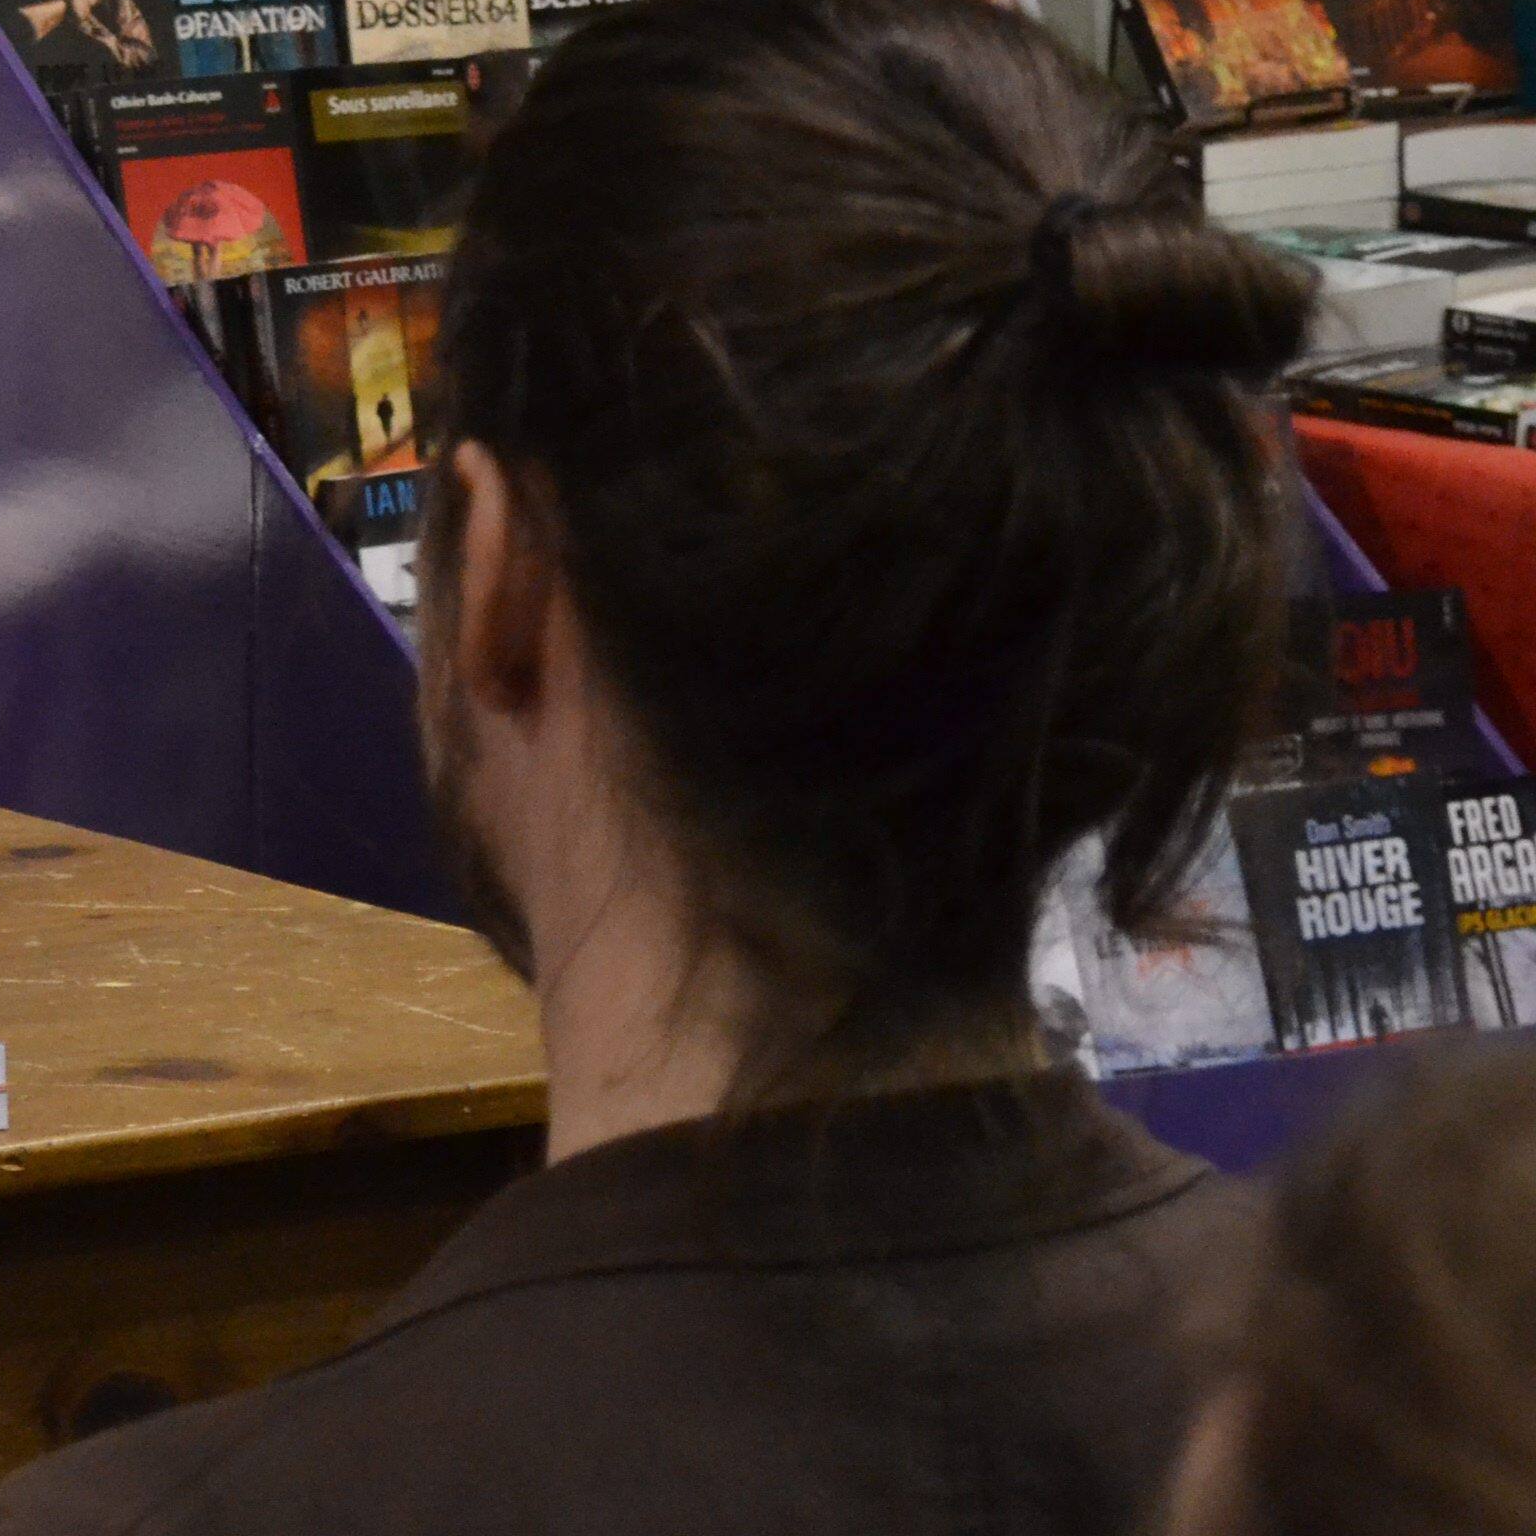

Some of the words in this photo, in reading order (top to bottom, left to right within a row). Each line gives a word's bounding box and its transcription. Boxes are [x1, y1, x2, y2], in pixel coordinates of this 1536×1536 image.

[174, 4, 328, 42] OFANATION
[329, 95, 368, 116] Sous
[370, 89, 459, 114] surveillance
[285, 270, 353, 296] ROBERT
[356, 263, 443, 289] GALBRAIT
[364, 479, 416, 520] IAN
[1446, 794, 1523, 847] FRED
[1295, 836, 1414, 892] HIVER
[1447, 837, 1536, 905] ARGA
[1296, 881, 1426, 942] ROUGE
